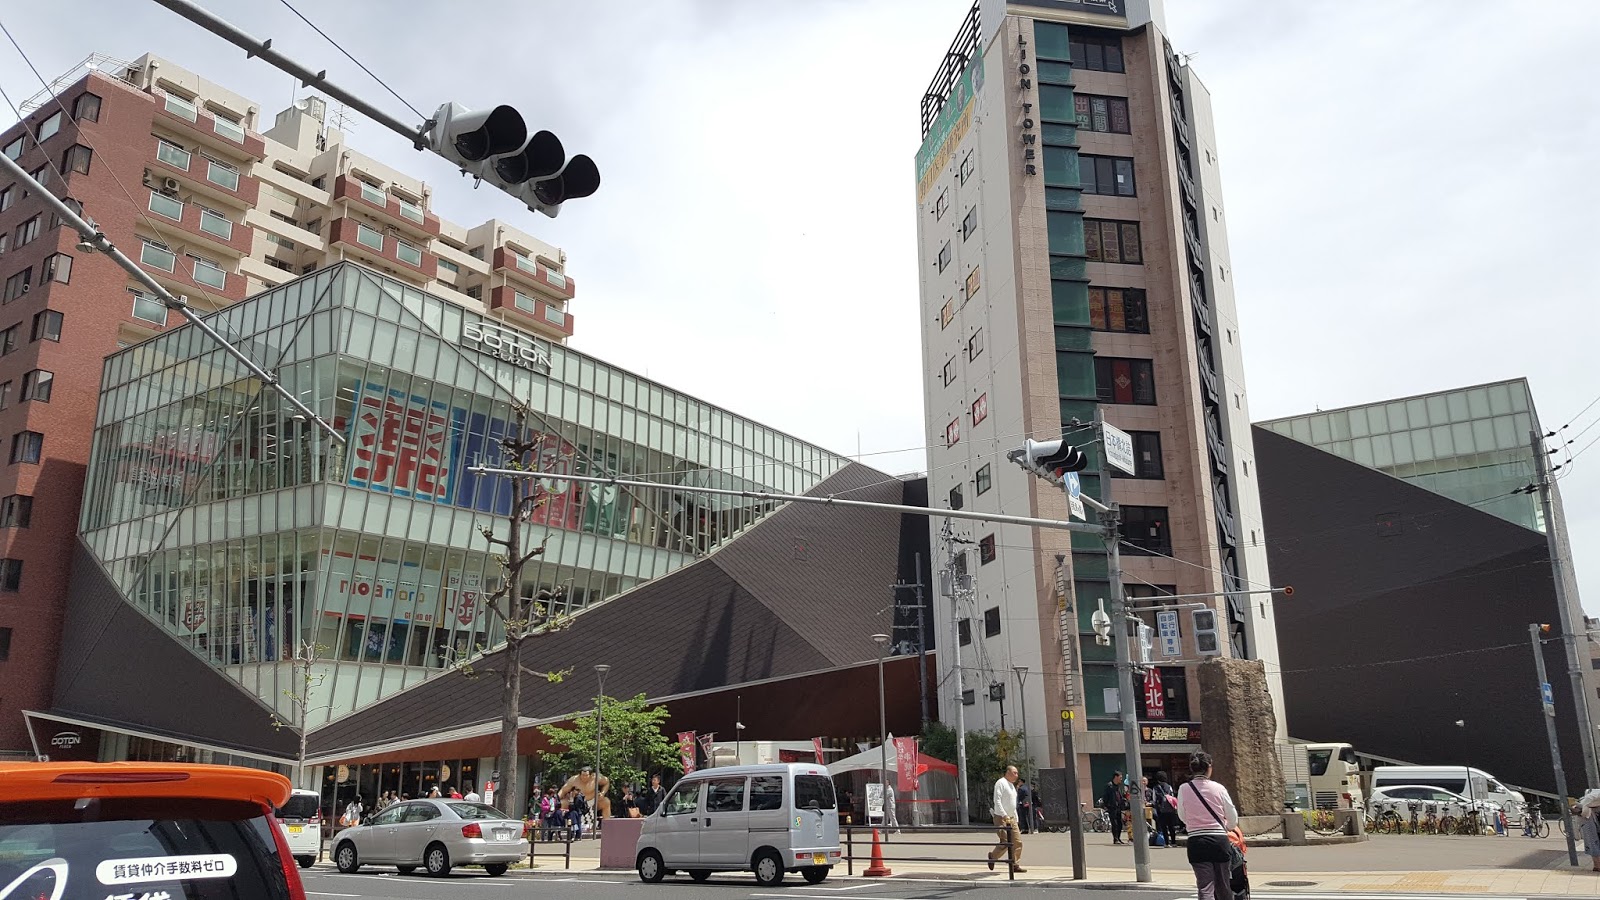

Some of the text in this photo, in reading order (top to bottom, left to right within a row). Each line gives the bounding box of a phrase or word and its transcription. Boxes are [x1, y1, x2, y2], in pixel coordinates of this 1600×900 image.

[1018, 34, 1037, 176] LION TOWER
[464, 323, 553, 369] DOTON
[492, 349, 529, 368] PLAZA
[1168, 614, 1176, 637] 歩行者
[1167, 638, 1175, 653] 専用
[51, 736, 81, 746] DOTON
[113, 860, 225, 879] 賃貸仲介手数料ゼロ
